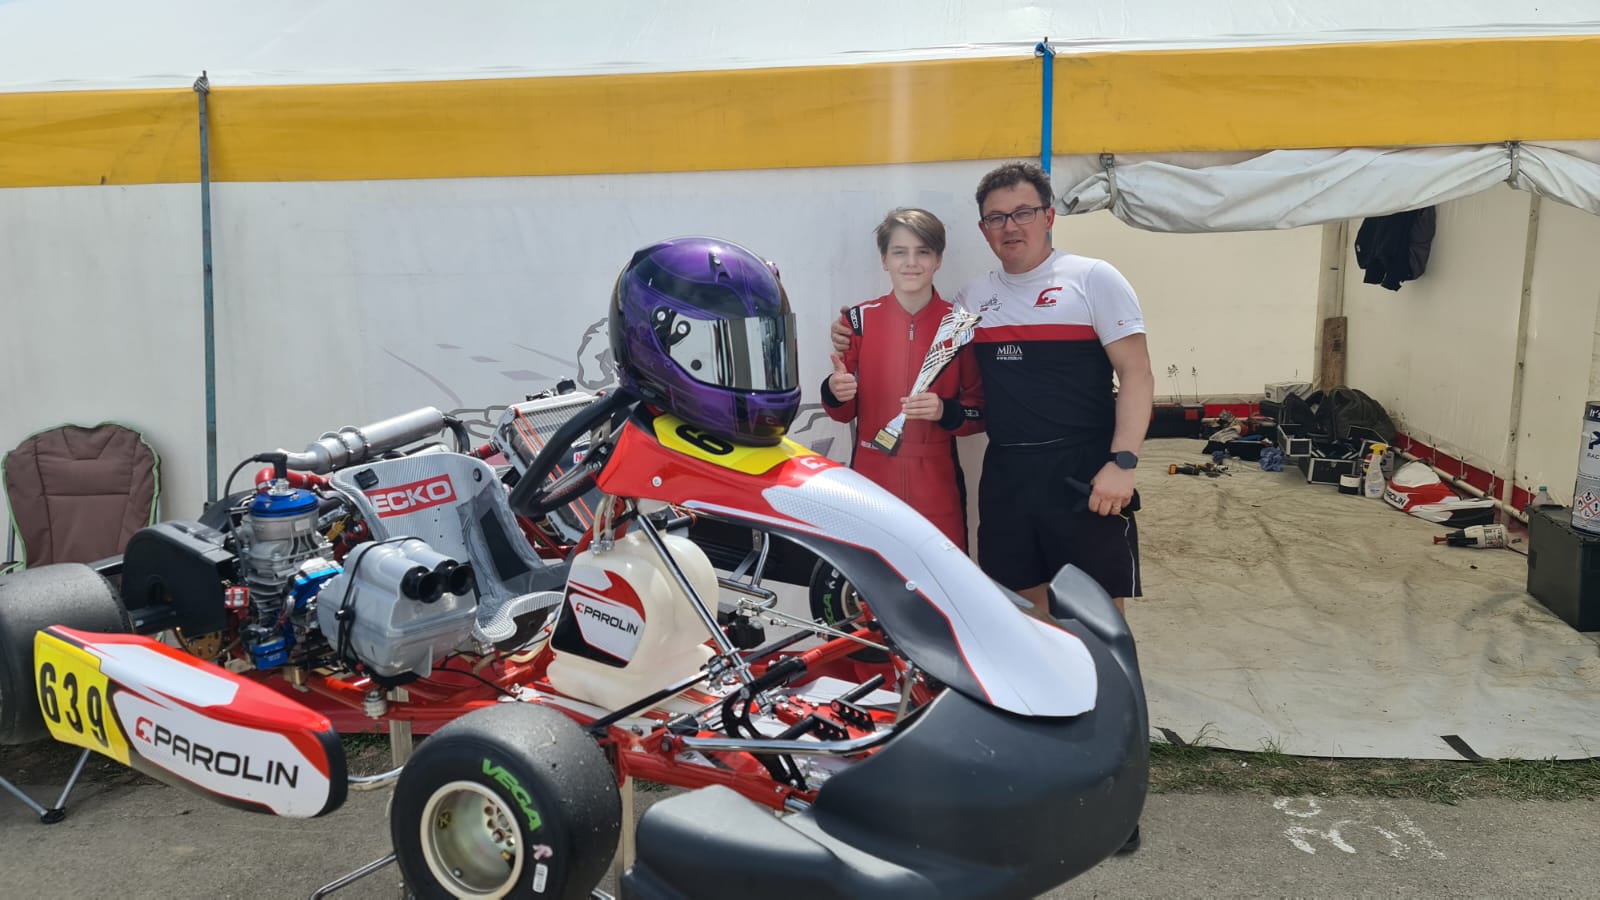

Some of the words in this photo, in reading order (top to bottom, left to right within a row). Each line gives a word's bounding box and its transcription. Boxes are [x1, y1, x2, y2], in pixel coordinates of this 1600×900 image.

[996, 344, 1023, 355] MIDA
[369, 480, 452, 513] ECKO
[583, 605, 639, 636] PAROLIN
[40, 662, 109, 748] 639
[153, 724, 299, 789] PAROLIN
[482, 758, 542, 831] VEGA
